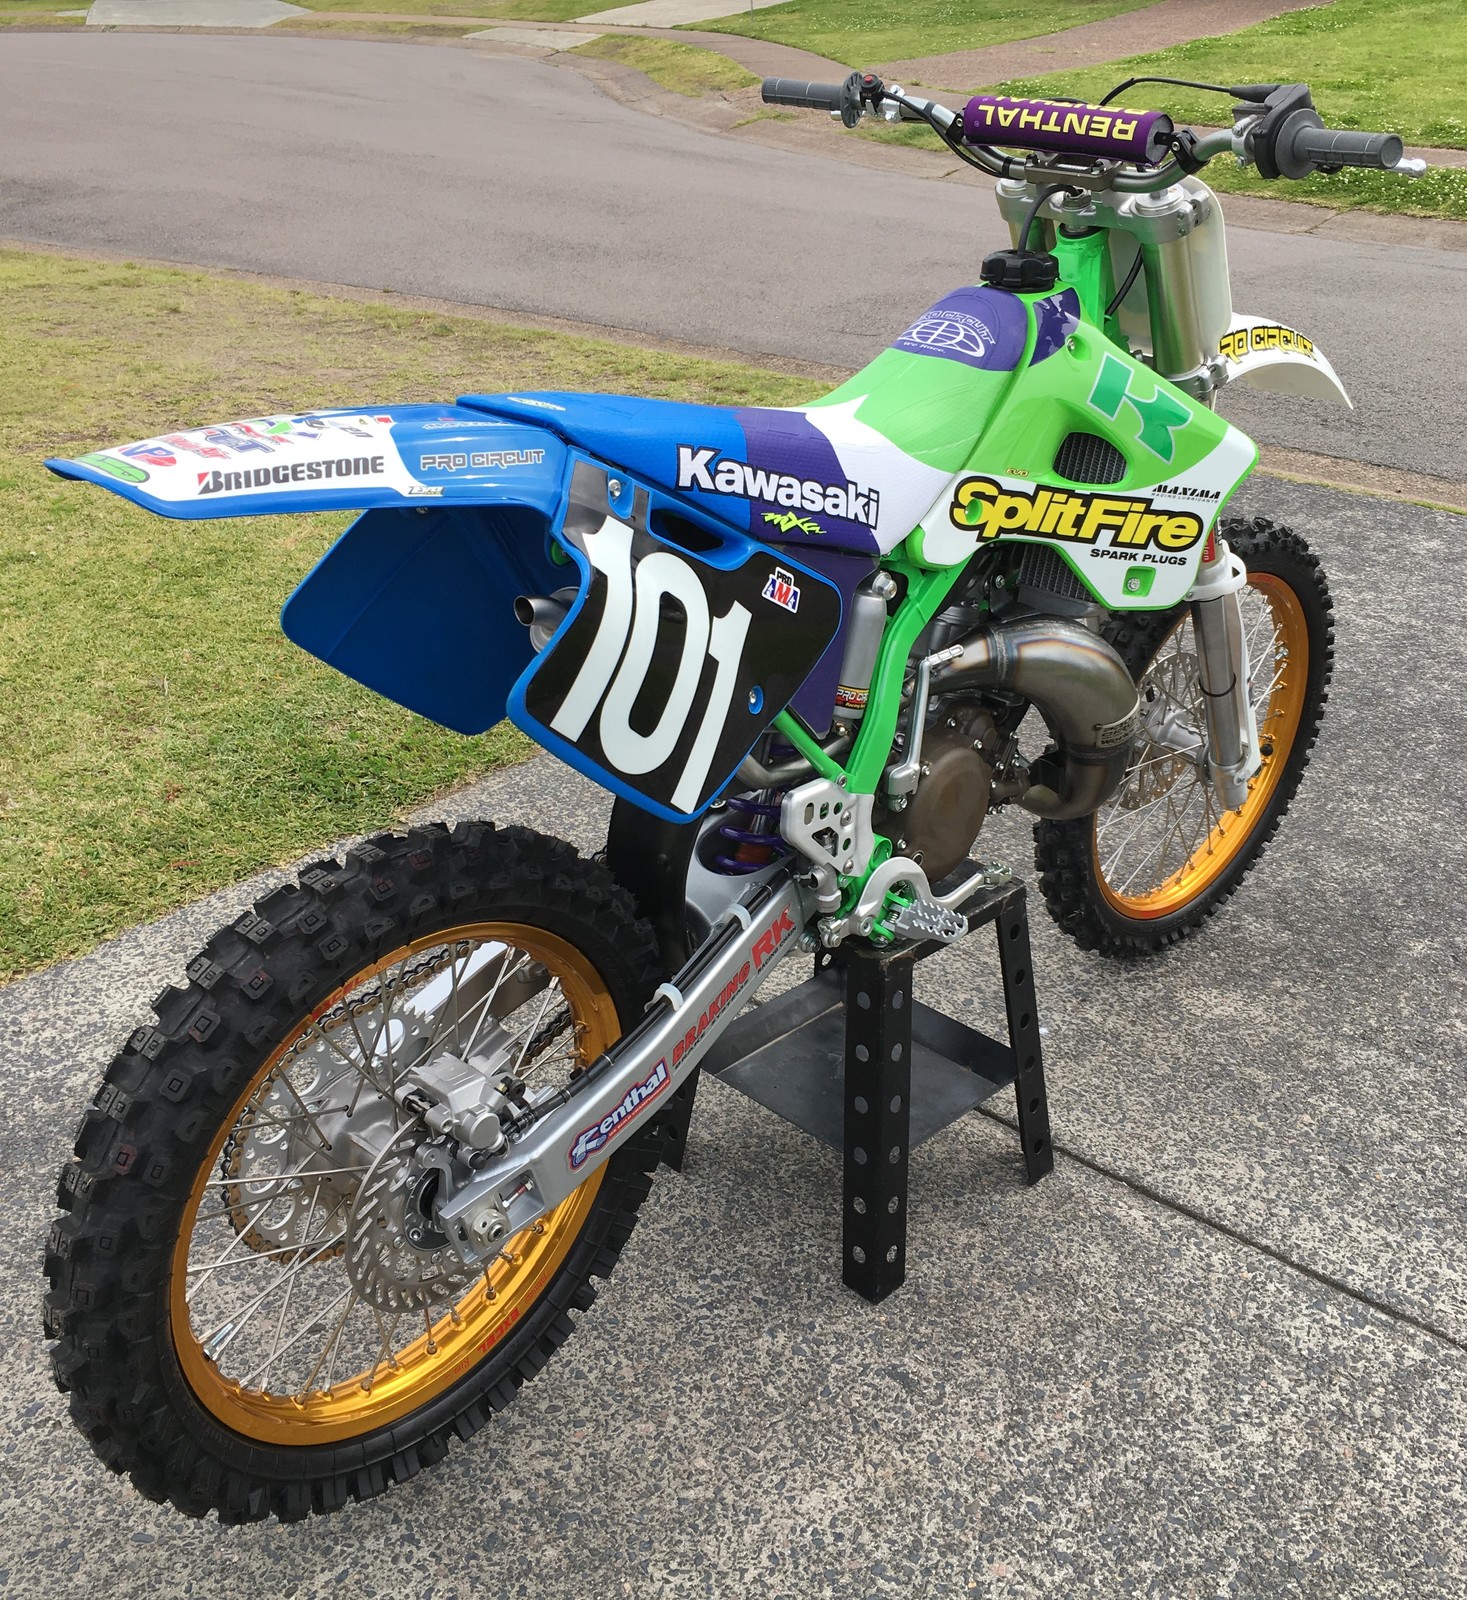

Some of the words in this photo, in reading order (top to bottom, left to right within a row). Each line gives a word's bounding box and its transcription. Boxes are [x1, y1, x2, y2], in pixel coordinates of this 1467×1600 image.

[978, 104, 1138, 141] RENTHAL
[942, 310, 996, 345] CIRCUIT
[1251, 325, 1319, 363] CIRCUIT
[197, 456, 385, 495] BRIDGESTONE
[421, 454, 466, 471] PRO
[471, 450, 544, 469] CIRCUIT
[675, 444, 879, 530] Kawasaki
[951, 478, 1201, 551] SplitFire
[1090, 548, 1139, 563] SPARK
[1142, 554, 1187, 566] PLUGS
[763, 577, 799, 611] AMA
[777, 570, 793, 586] PRO
[549, 514, 753, 815] 101
[836, 689, 857, 702] PRO
[752, 902, 796, 969] RK
[672, 960, 751, 1067] BRAKING
[571, 1062, 668, 1167] Renthal
[477, 1306, 521, 1354] EXCEL
